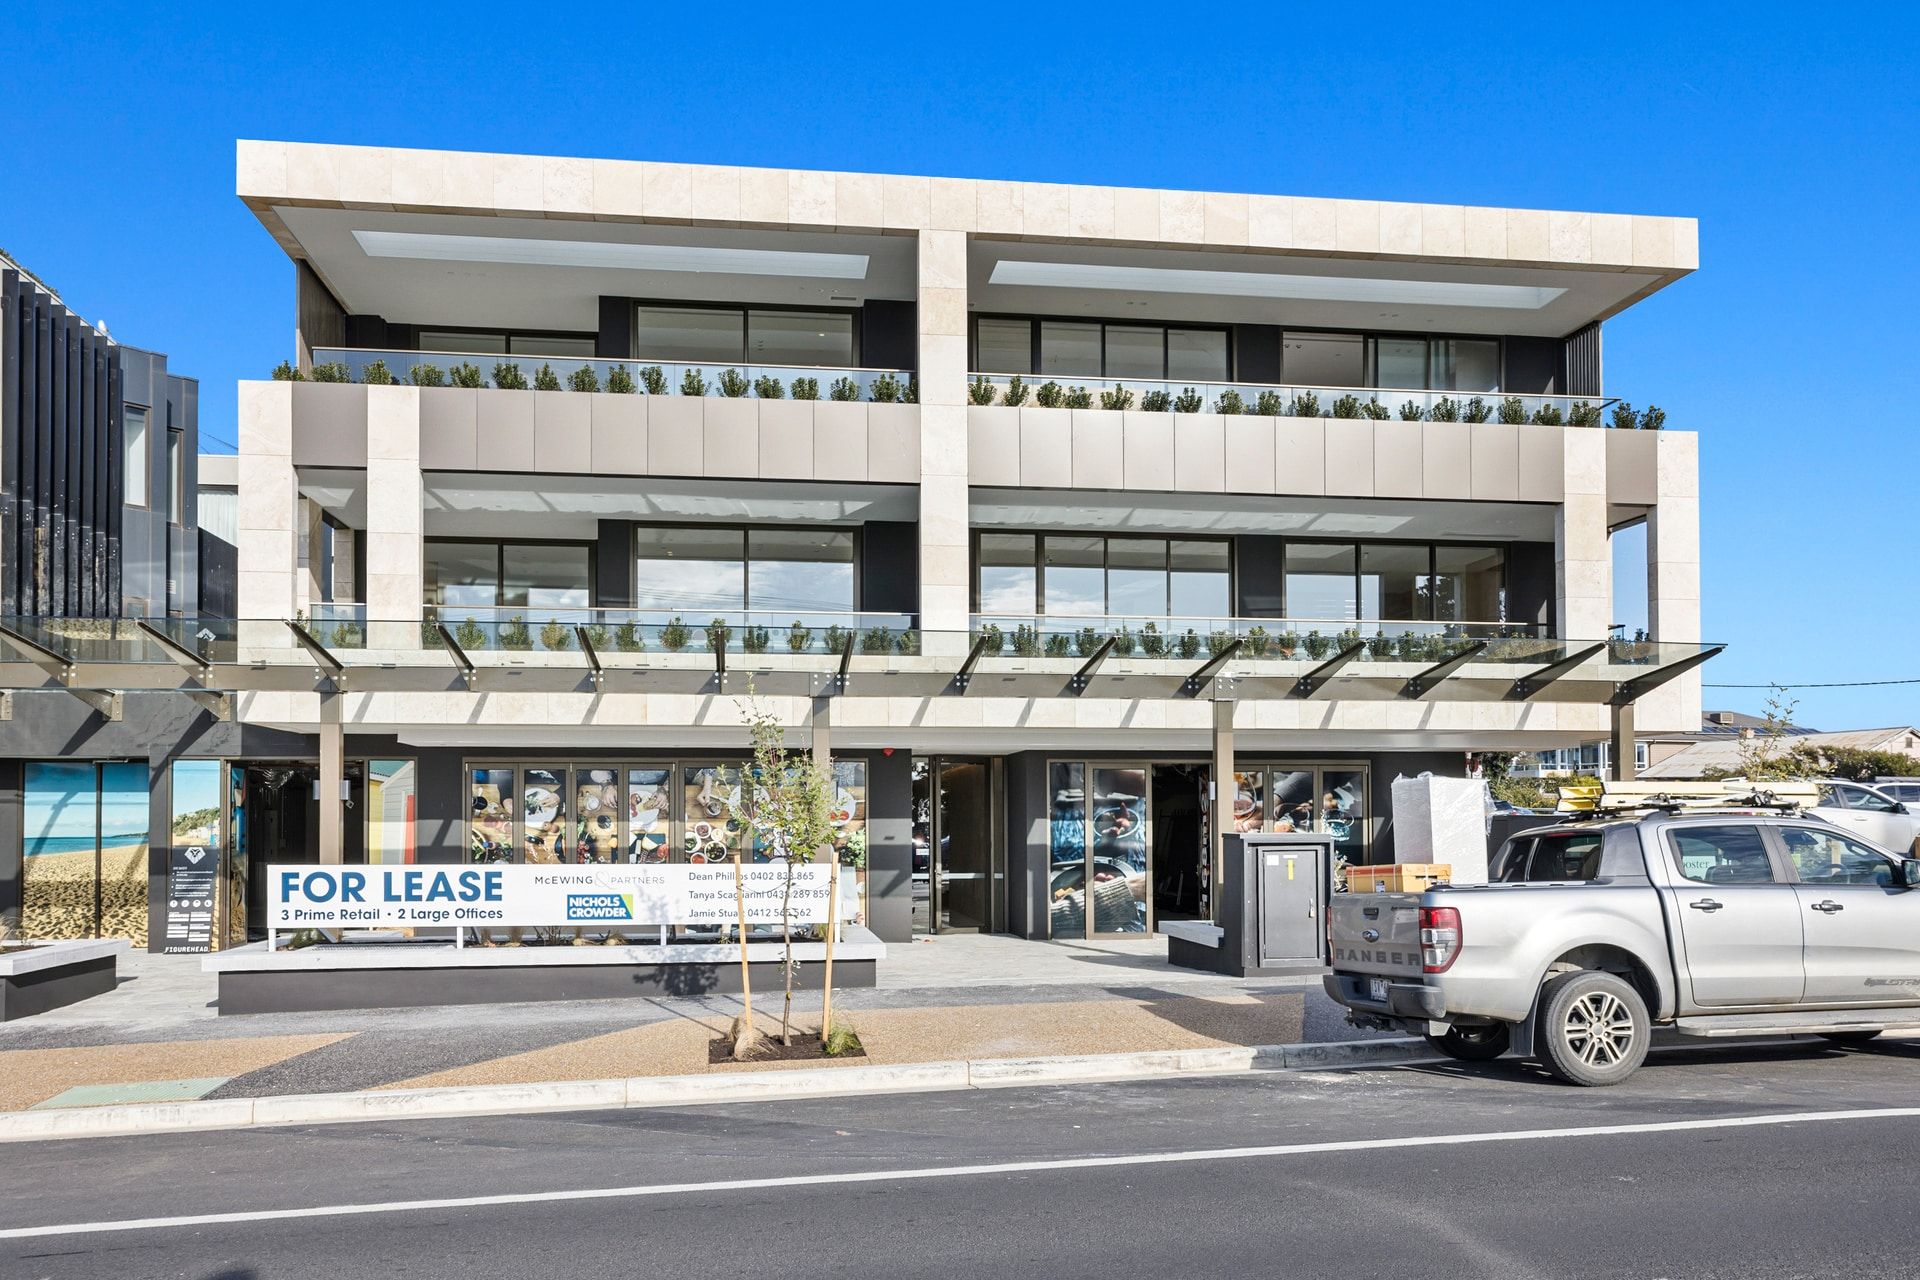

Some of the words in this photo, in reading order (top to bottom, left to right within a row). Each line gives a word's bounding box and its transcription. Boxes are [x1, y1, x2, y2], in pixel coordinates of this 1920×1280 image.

[1683, 860, 1708, 868] oster
[534, 876, 593, 885] McEWING
[611, 876, 665, 885] PARTNERS
[688, 872, 713, 881] Dean
[715, 872, 748, 881] Phillps
[750, 871, 774, 880] 0402
[796, 871, 815, 880] 865
[281, 871, 366, 903] FOR
[383, 870, 503, 902] LEASE
[688, 890, 715, 901] Tanya
[717, 890, 764, 901] Scagiarini
[793, 889, 811, 899] 289
[812, 889, 831, 899] 859
[569, 896, 620, 907] NICHOLS
[281, 909, 290, 921] 3
[294, 909, 335, 921] Prime
[340, 908, 380, 921] Retail
[397, 908, 406, 920] 2
[411, 908, 450, 922] Large
[455, 907, 503, 920] Offices
[569, 907, 627, 918] CROWDER
[688, 908, 716, 918] Jamie
[718, 908, 745, 918] Stua
[747, 908, 771, 917] 0412
[1335, 948, 1420, 966] RANGER
